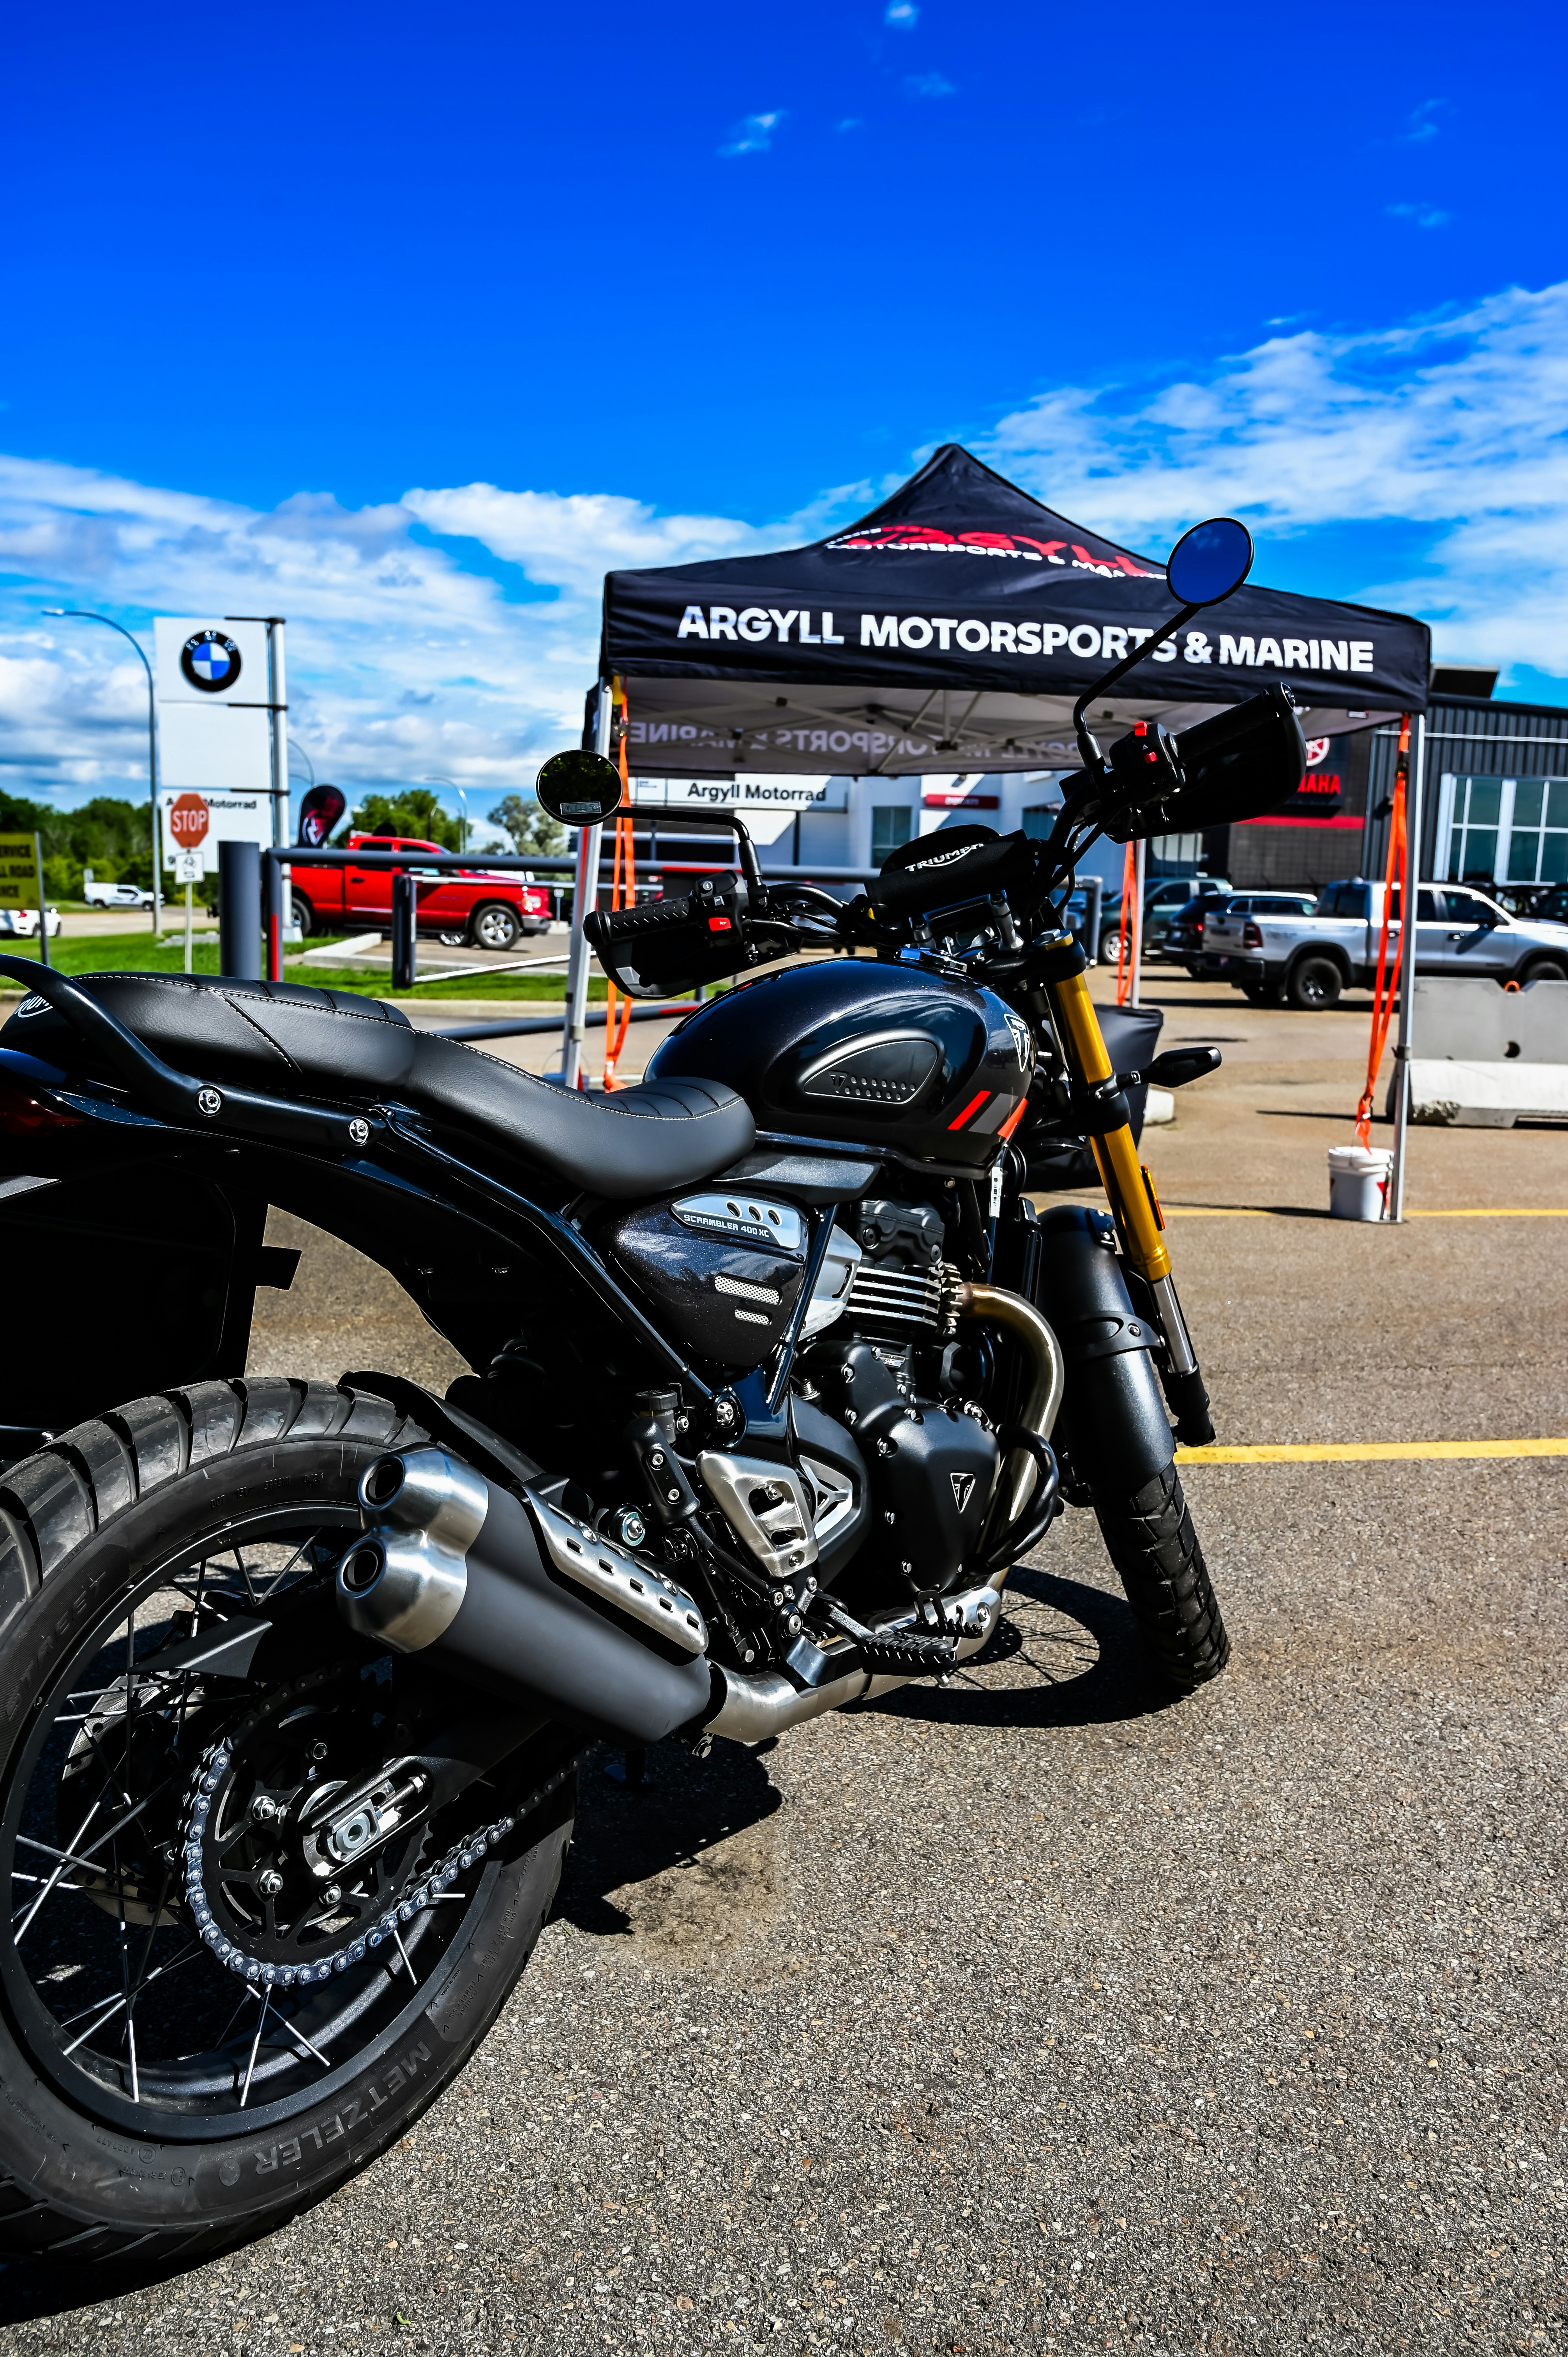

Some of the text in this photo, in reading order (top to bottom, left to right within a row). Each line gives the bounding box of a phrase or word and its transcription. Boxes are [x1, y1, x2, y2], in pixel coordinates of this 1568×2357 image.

[677, 605, 1374, 673] ARGYLL MOTORSPORTS & MARINE
[687, 783, 826, 803] Argyll Motorrad
[172, 809, 207, 833] STOP
[904, 843, 984, 872] TRIUMPH
[683, 1214, 770, 1238] SCRAMBLER 400 XC
[210, 1495, 226, 1509] DOT
[5, 1571, 106, 1724] STREET
[502, 1908, 512, 1922] RIM
[496, 1924, 505, 1938] FIT
[479, 1949, 493, 1970] TUBE
[452, 1968, 461, 1980] MADE
[441, 1985, 450, 1996] CHINA
[449, 1980, 477, 2019] TUBELESS
[457, 1989, 478, 2016] RADIAL
[254, 2041, 432, 2175] METZELER
